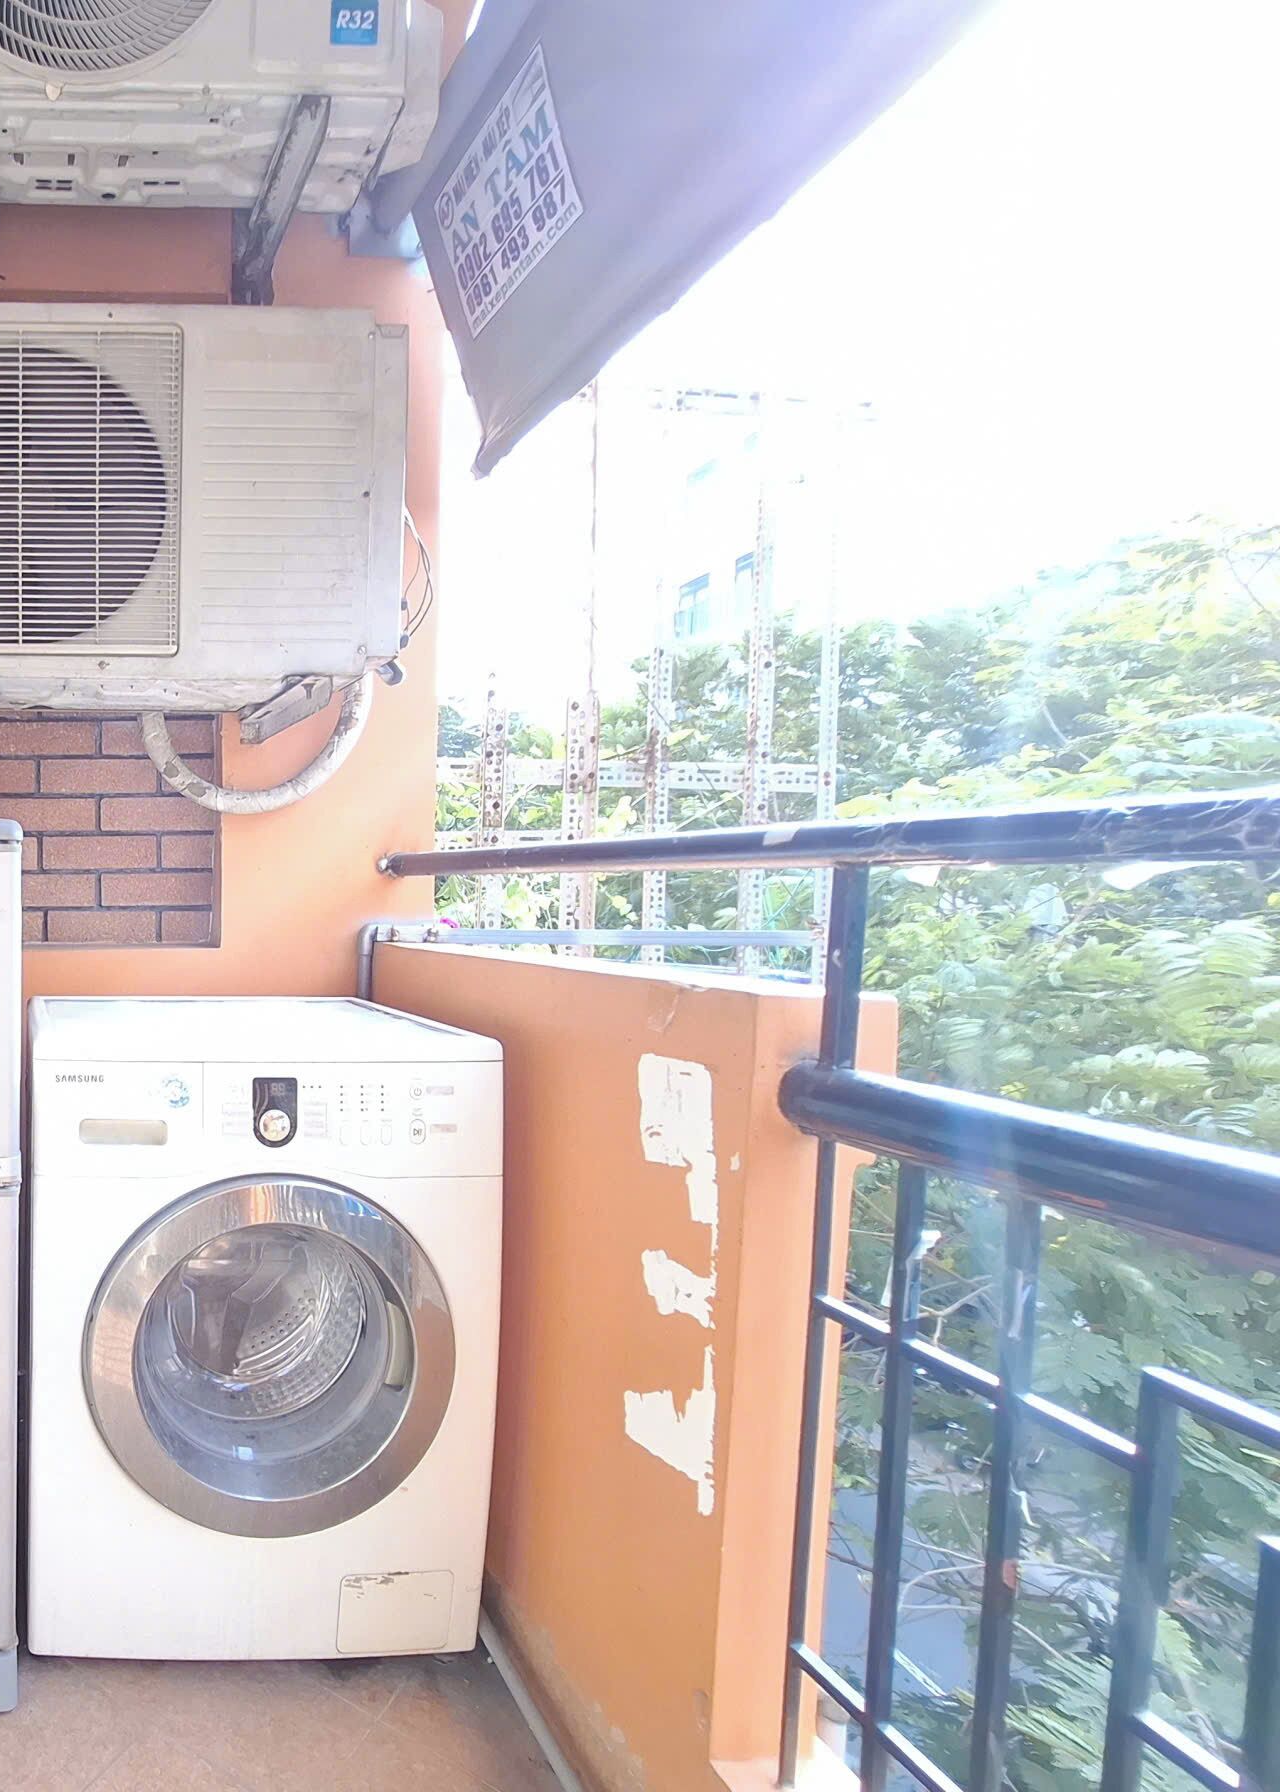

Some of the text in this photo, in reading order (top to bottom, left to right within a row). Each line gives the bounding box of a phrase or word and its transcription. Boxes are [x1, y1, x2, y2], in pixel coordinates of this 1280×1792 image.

[335, 10, 375, 29] R32
[452, 100, 552, 264] AN TÂM
[458, 139, 560, 291] 0902 695 761
[500, 224, 529, 270] 493
[531, 173, 567, 232] 987
[55, 1074, 105, 1083] SAMSUNG
